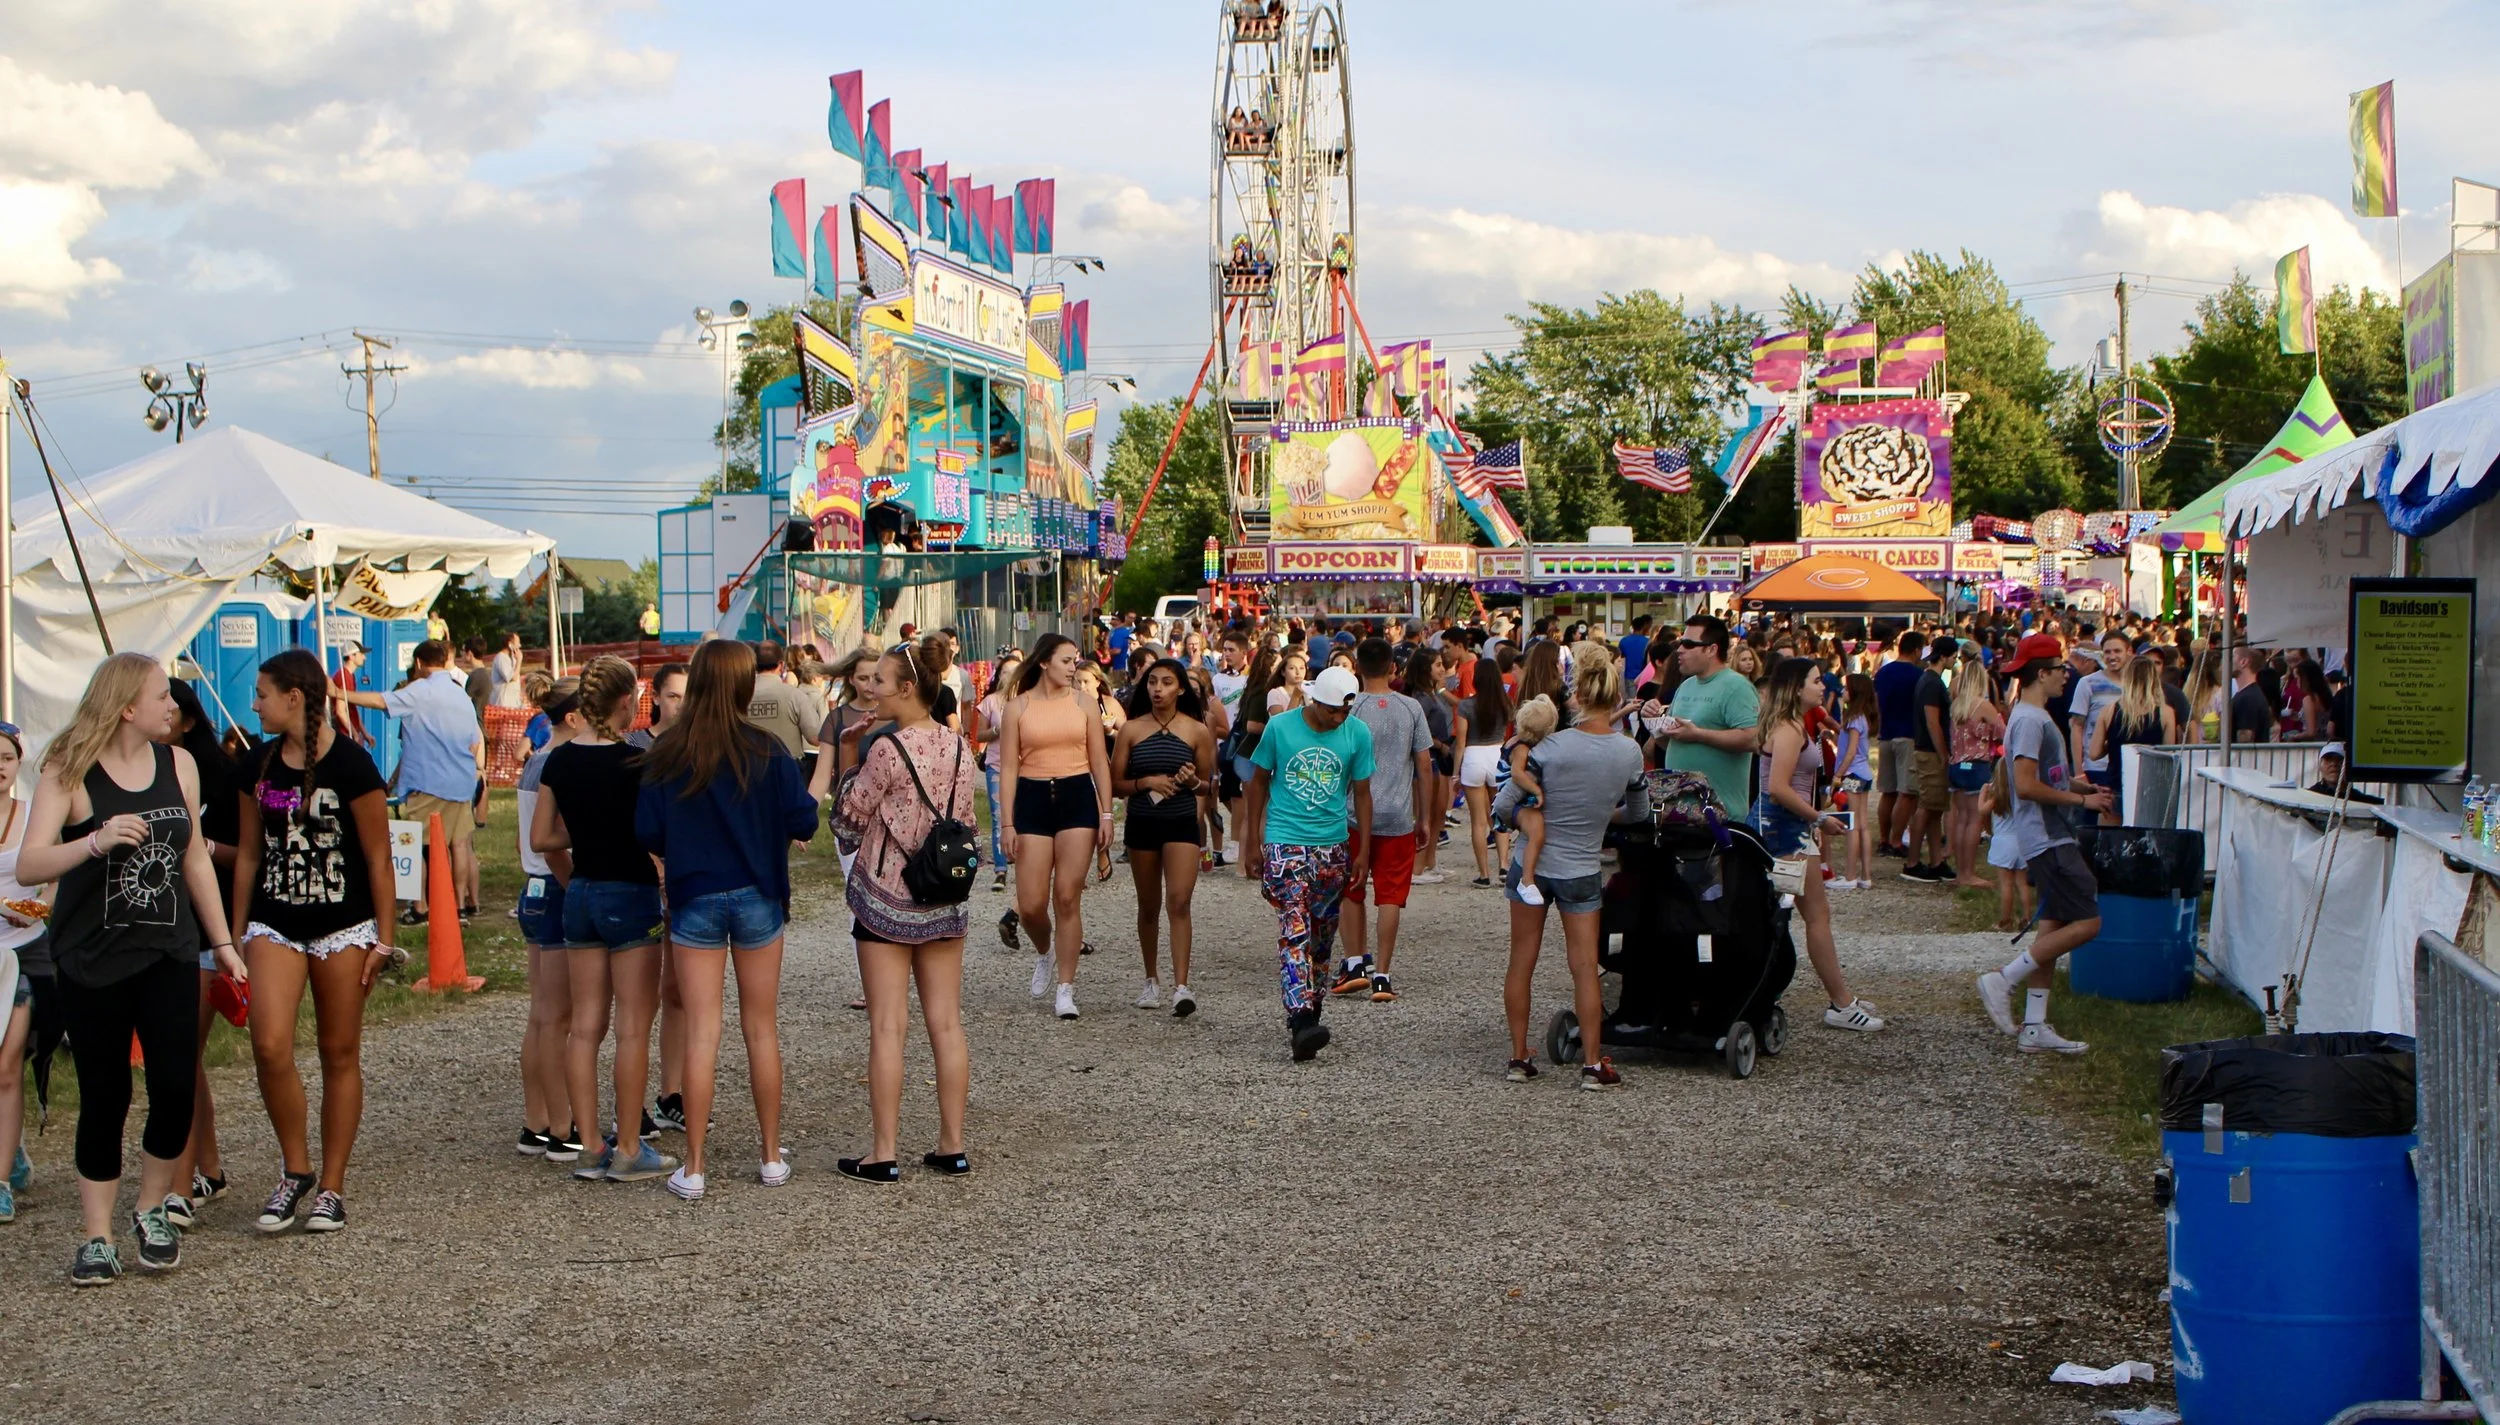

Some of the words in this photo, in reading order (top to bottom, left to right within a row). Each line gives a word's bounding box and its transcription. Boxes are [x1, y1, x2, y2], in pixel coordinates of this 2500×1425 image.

[1302, 510, 1324, 521] YUM
[1327, 508, 1349, 520] YUM
[1834, 510, 1873, 523] SWEET
[1874, 502, 1917, 518] SHOPPE
[1281, 551, 1398, 568] POPCORN
[1430, 550, 1442, 558] ICE
[1443, 550, 1461, 558] COLD
[1885, 549, 1940, 566] CAKES
[1236, 560, 1266, 570] DRINKS
[1427, 559, 1465, 569] DRINKS
[1539, 556, 1676, 574] TICKETS
[1957, 558, 1999, 569] FRIES
[2379, 599, 2449, 616] Davidson's
[221, 620, 255, 631] Service
[2386, 631, 2406, 640] Burger
[2423, 644, 2440, 652] Wrap
[748, 702, 777, 717] HERIFF
[150, 808, 186, 820] CHILD
